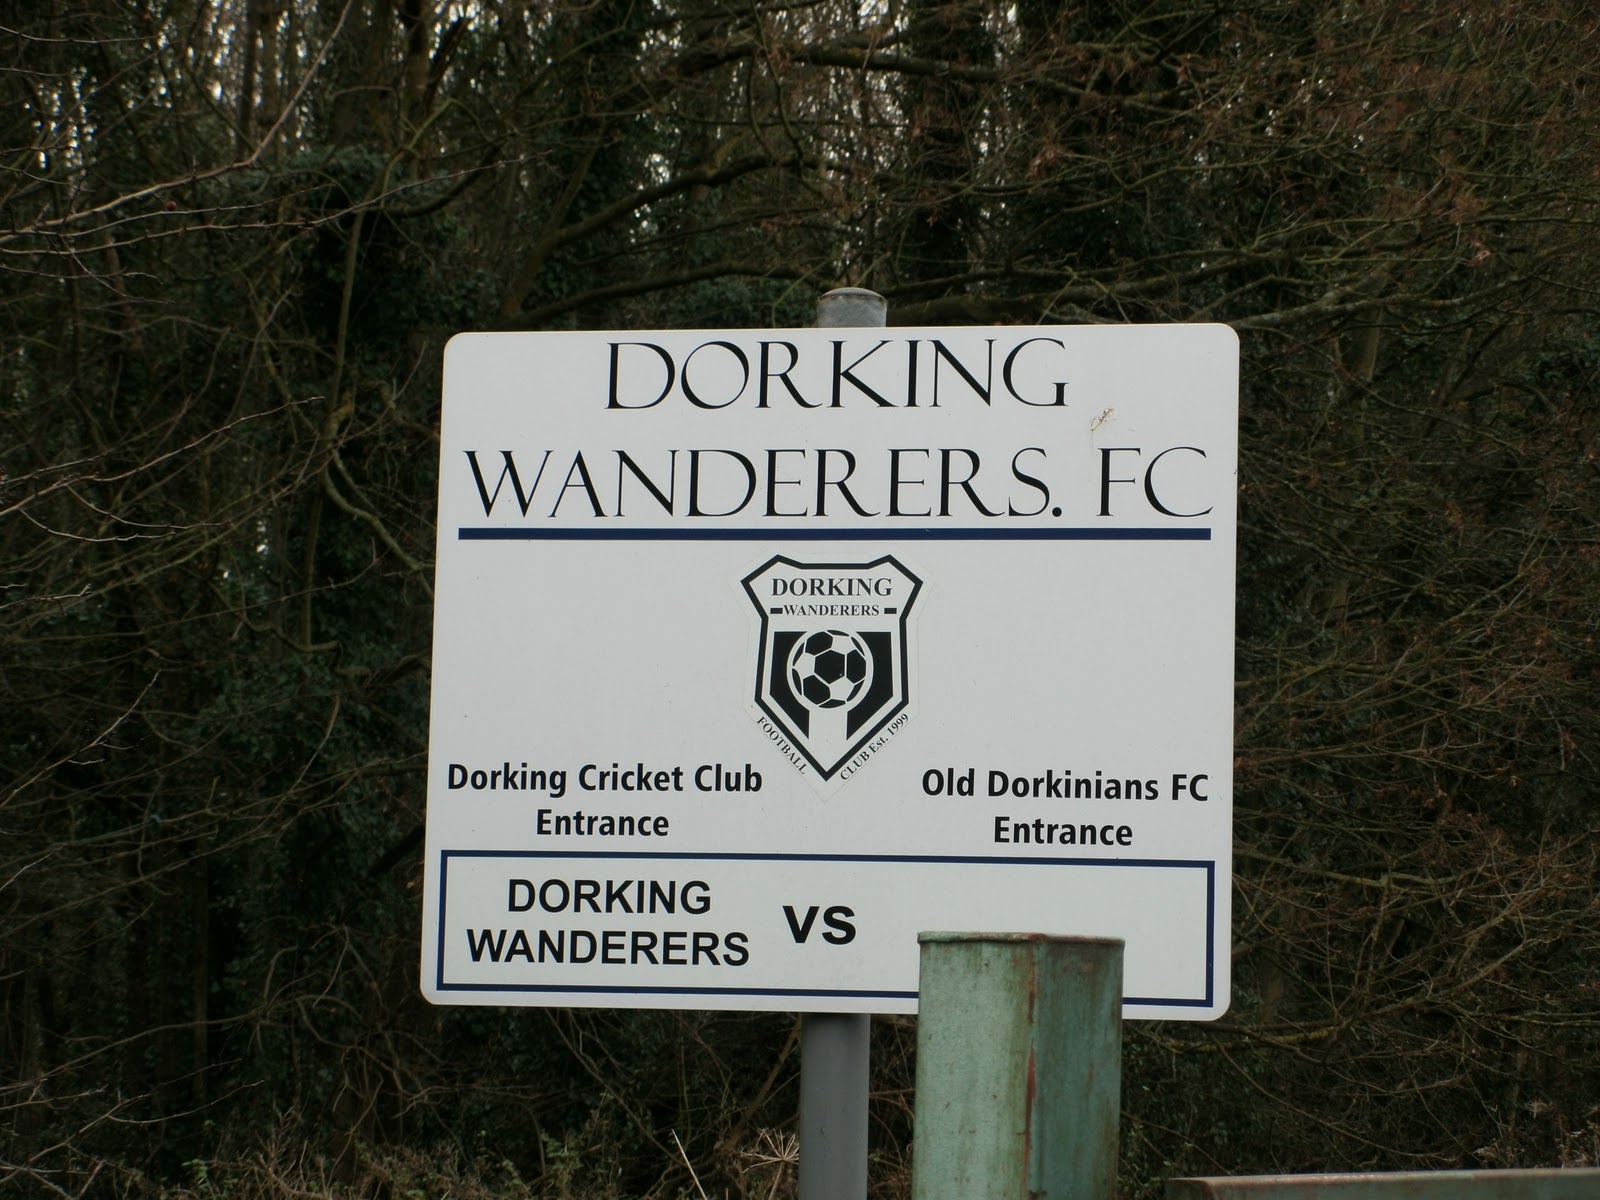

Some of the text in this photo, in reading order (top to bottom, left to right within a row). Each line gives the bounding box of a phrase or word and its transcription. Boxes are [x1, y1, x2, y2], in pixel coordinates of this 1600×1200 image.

[606, 338, 1068, 410] DORKING
[464, 447, 1214, 518] WANDERERS. FC
[771, 577, 893, 597] DORKING
[783, 604, 880, 617] WANDERERS
[756, 716, 808, 775] FOOTBALL
[840, 713, 909, 780] CLUB Est. 1999
[448, 762, 763, 799] Dorking Cricket Club
[922, 767, 1209, 802] Old Dorkinians FC
[536, 808, 670, 837] Entrance
[994, 816, 1133, 847] Entrance
[508, 878, 711, 915] DORKING
[467, 929, 750, 967] WANDERERS
